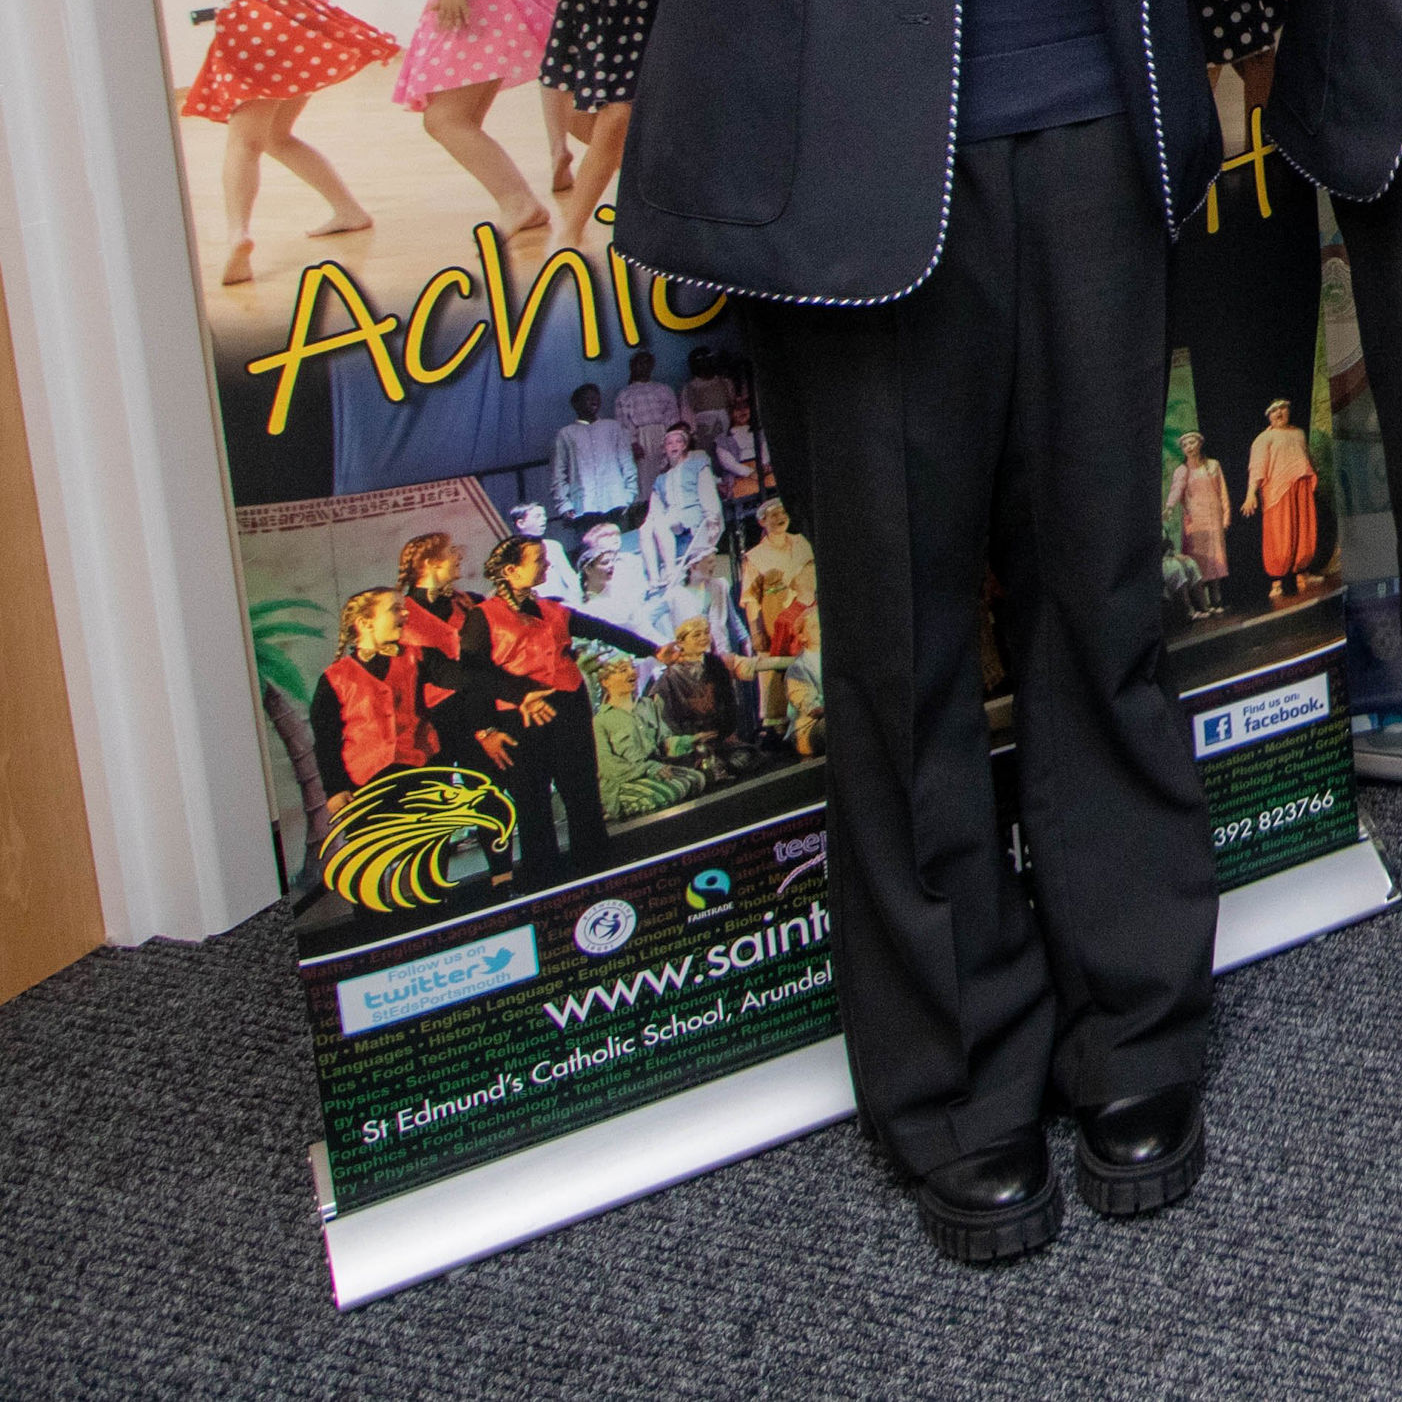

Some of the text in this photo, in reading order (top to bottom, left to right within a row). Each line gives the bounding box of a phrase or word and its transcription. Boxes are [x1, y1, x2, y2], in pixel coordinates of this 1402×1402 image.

[1242, 700, 1265, 718] Find
[1267, 697, 1281, 709] us
[1243, 694, 1324, 735] facebook.
[1212, 787, 1335, 849] 392 823766
[687, 901, 735, 924] FAIRTRADE
[387, 943, 486, 983] Follow us on
[363, 961, 481, 1013] twitter
[371, 969, 511, 1025] StEdsPortsmouth
[363, 959, 832, 1143] St Edmund's Catholic School, Arundel
